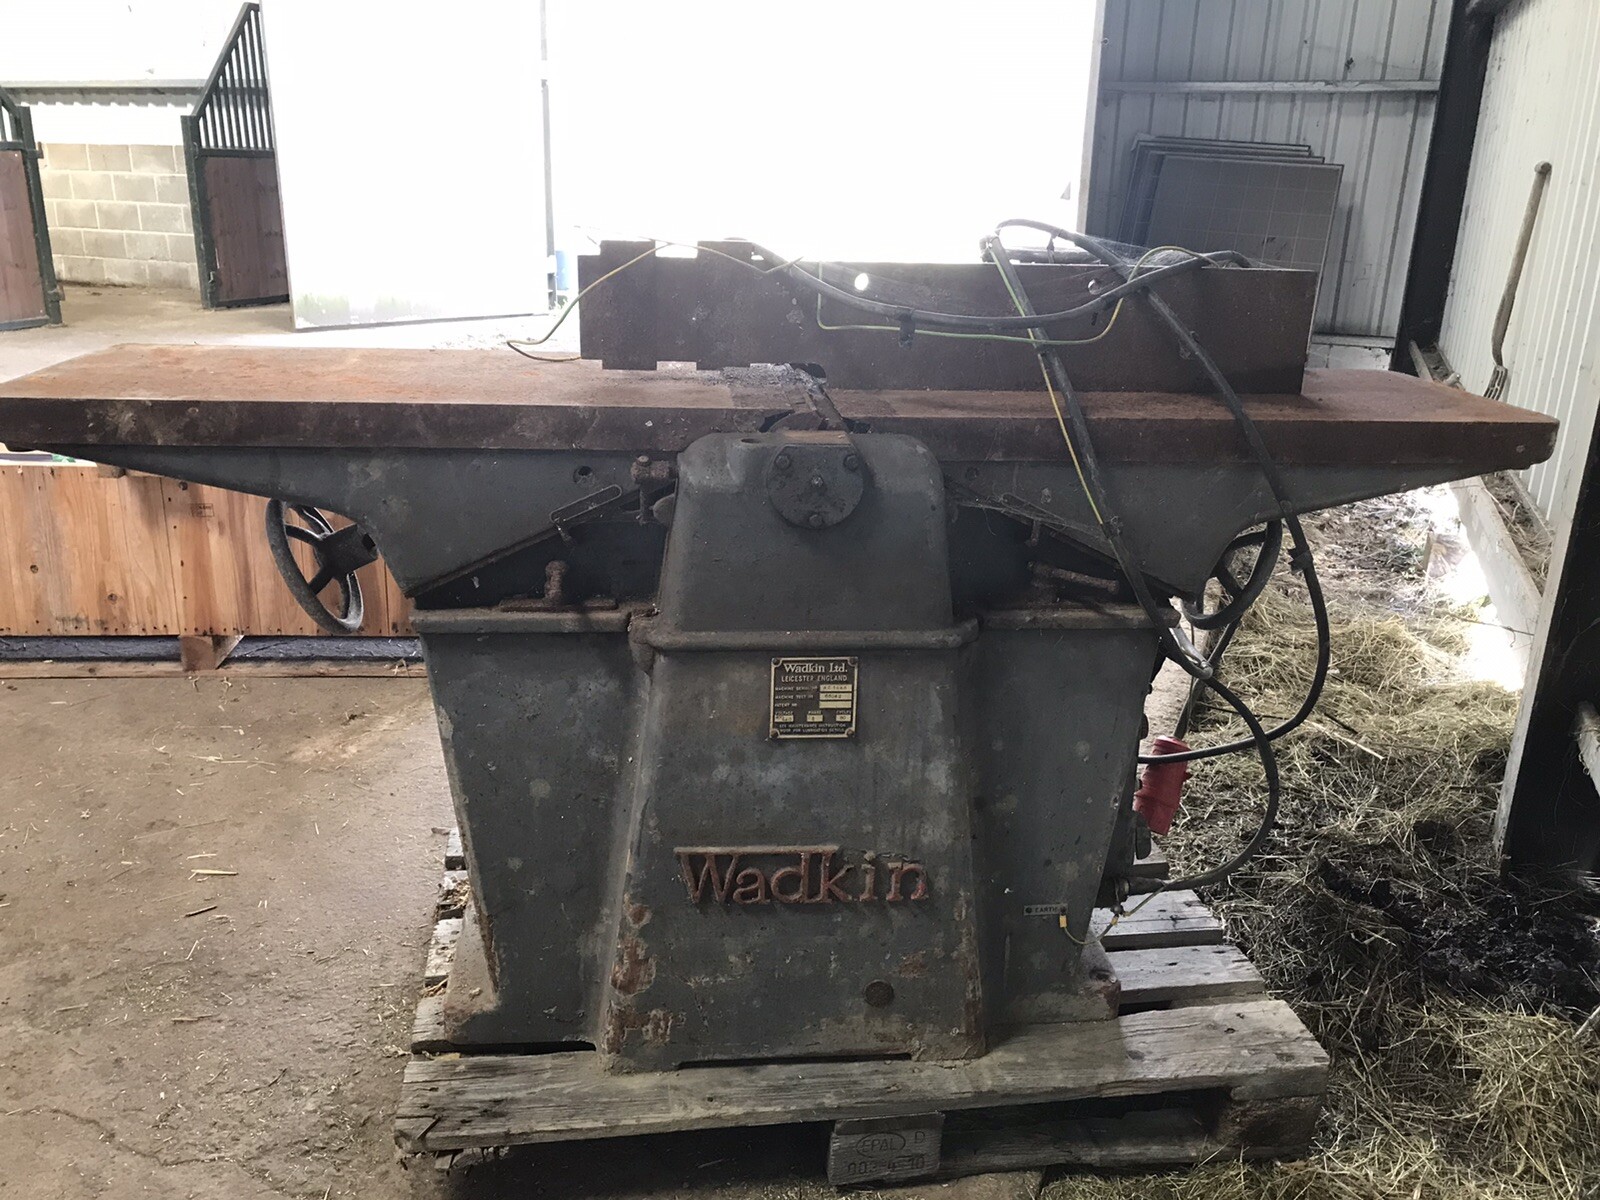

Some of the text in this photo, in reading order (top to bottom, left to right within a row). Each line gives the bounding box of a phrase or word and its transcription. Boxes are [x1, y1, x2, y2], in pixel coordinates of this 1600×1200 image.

[784, 662, 848, 673] Wadkin Ltd.
[673, 844, 930, 905] Wadkin
[862, 1137, 898, 1153] EPAL
